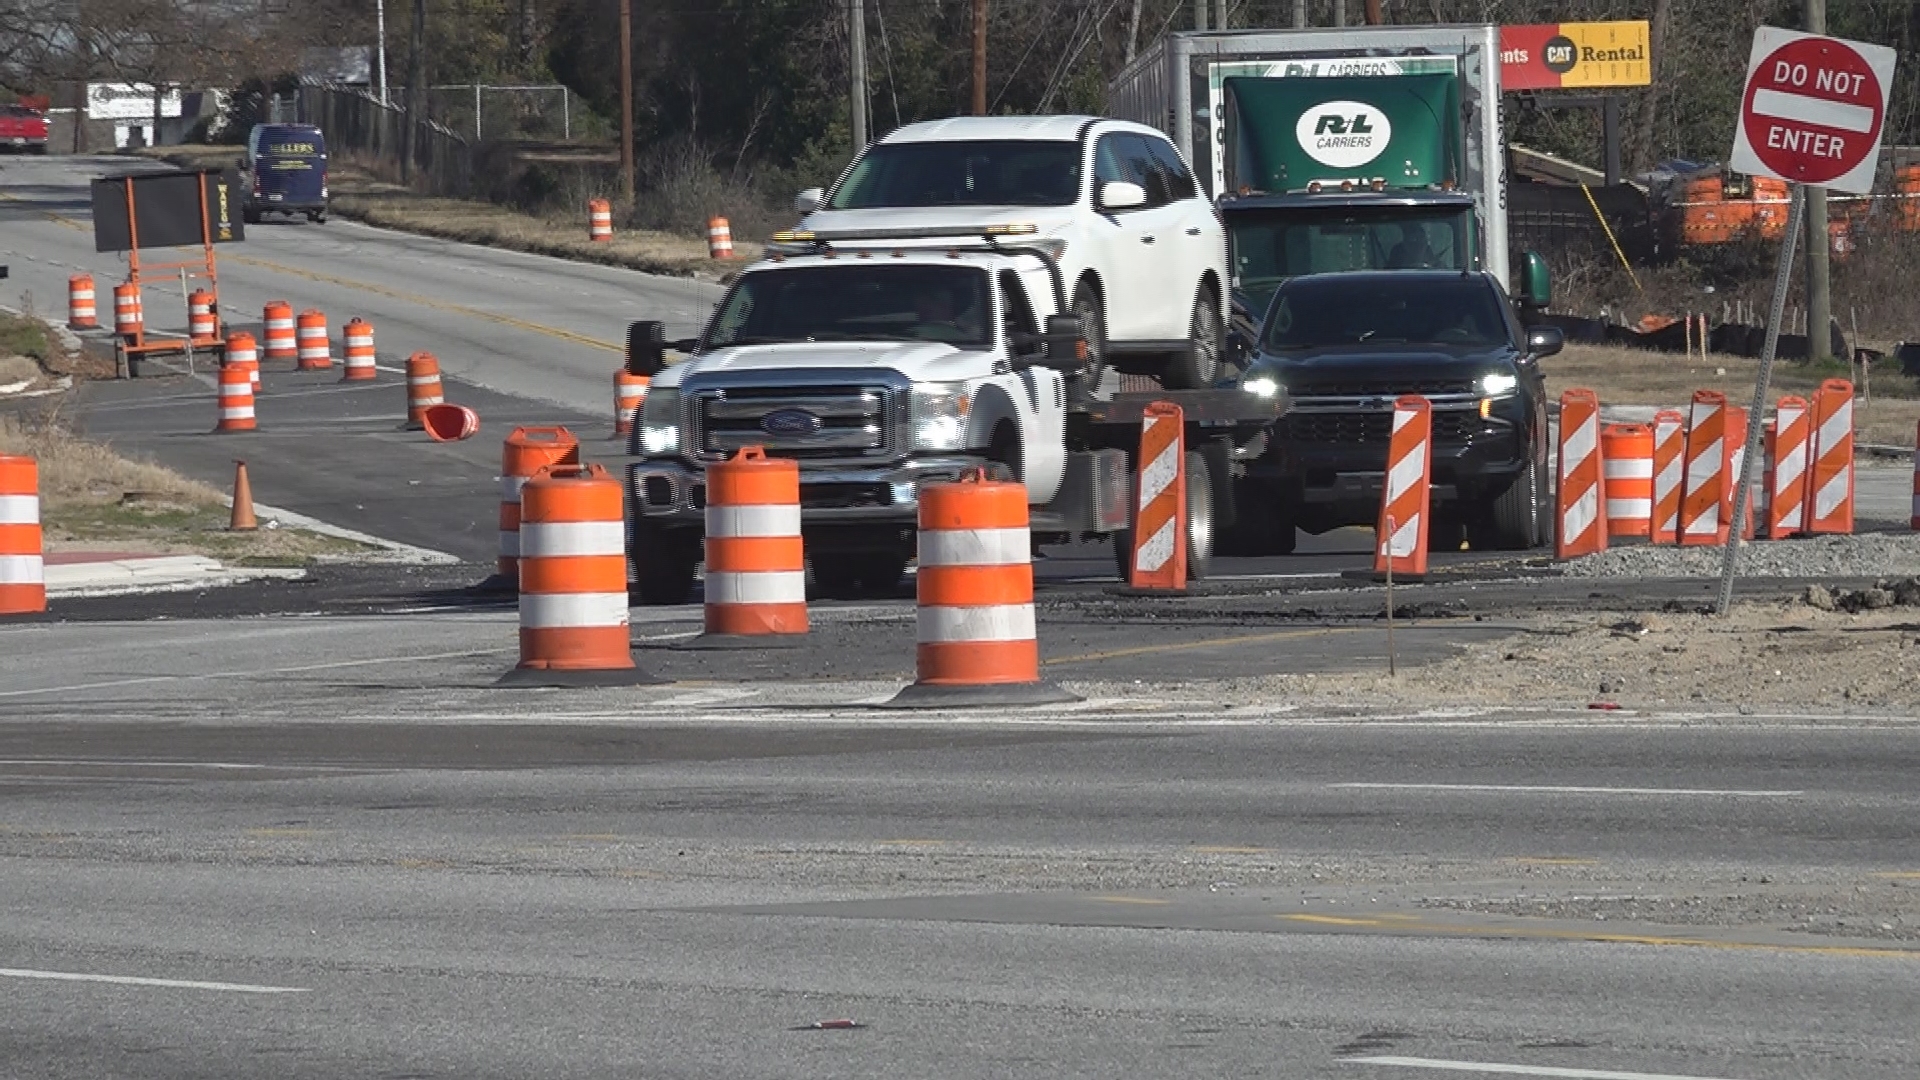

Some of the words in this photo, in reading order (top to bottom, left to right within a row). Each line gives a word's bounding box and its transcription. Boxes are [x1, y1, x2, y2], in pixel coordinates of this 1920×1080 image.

[1547, 46, 1572, 64] CAT
[1581, 44, 1644, 62] Rental
[1773, 60, 1808, 86] DO
[1815, 68, 1866, 96] NOT
[1316, 136, 1373, 149] CARRIERS
[1767, 125, 1845, 160] ENTER
